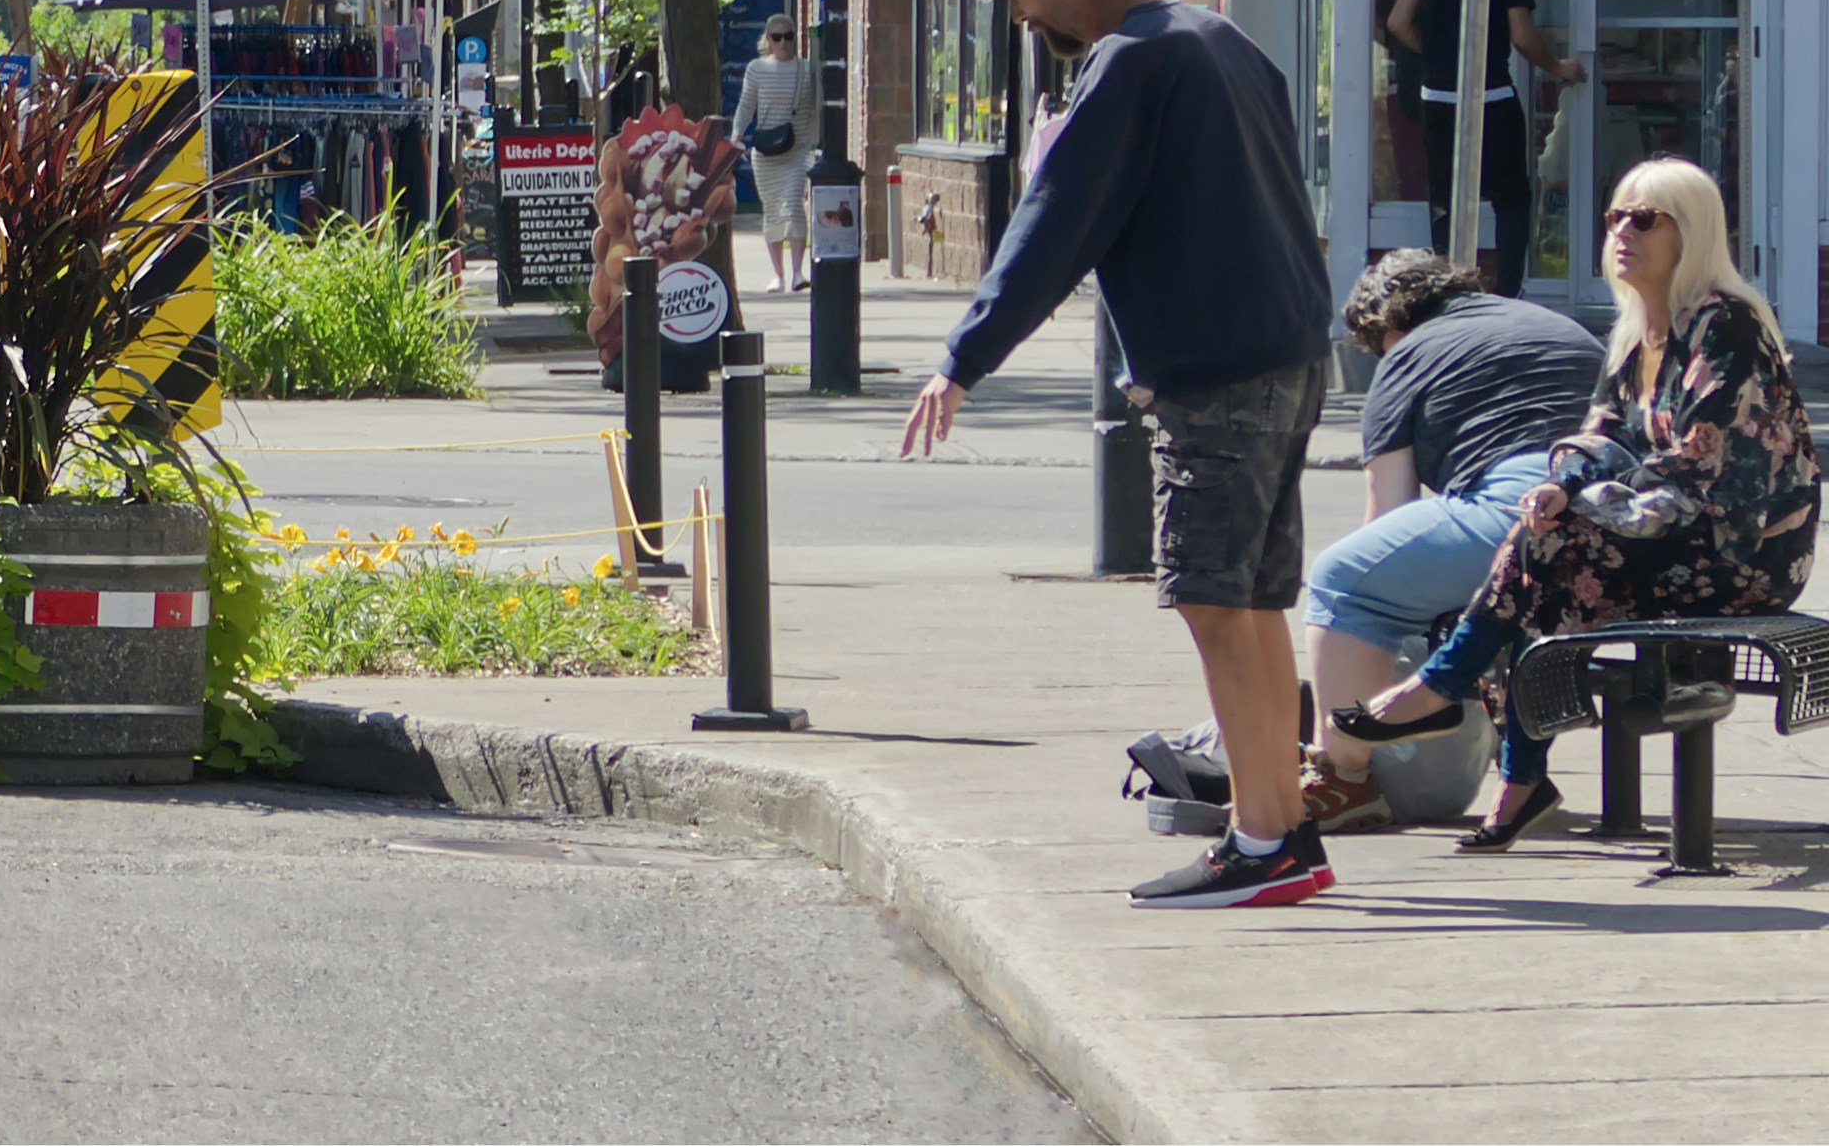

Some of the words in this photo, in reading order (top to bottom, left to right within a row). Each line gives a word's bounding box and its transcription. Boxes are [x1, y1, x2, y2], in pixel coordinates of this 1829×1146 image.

[504, 143, 553, 161] Literie
[503, 171, 581, 192] LIQUIDATION
[519, 207, 590, 219] MEUBLES
[519, 218, 586, 230] RIDEAUX
[520, 253, 582, 263] TAPIS
[522, 276, 553, 286] ACC.
